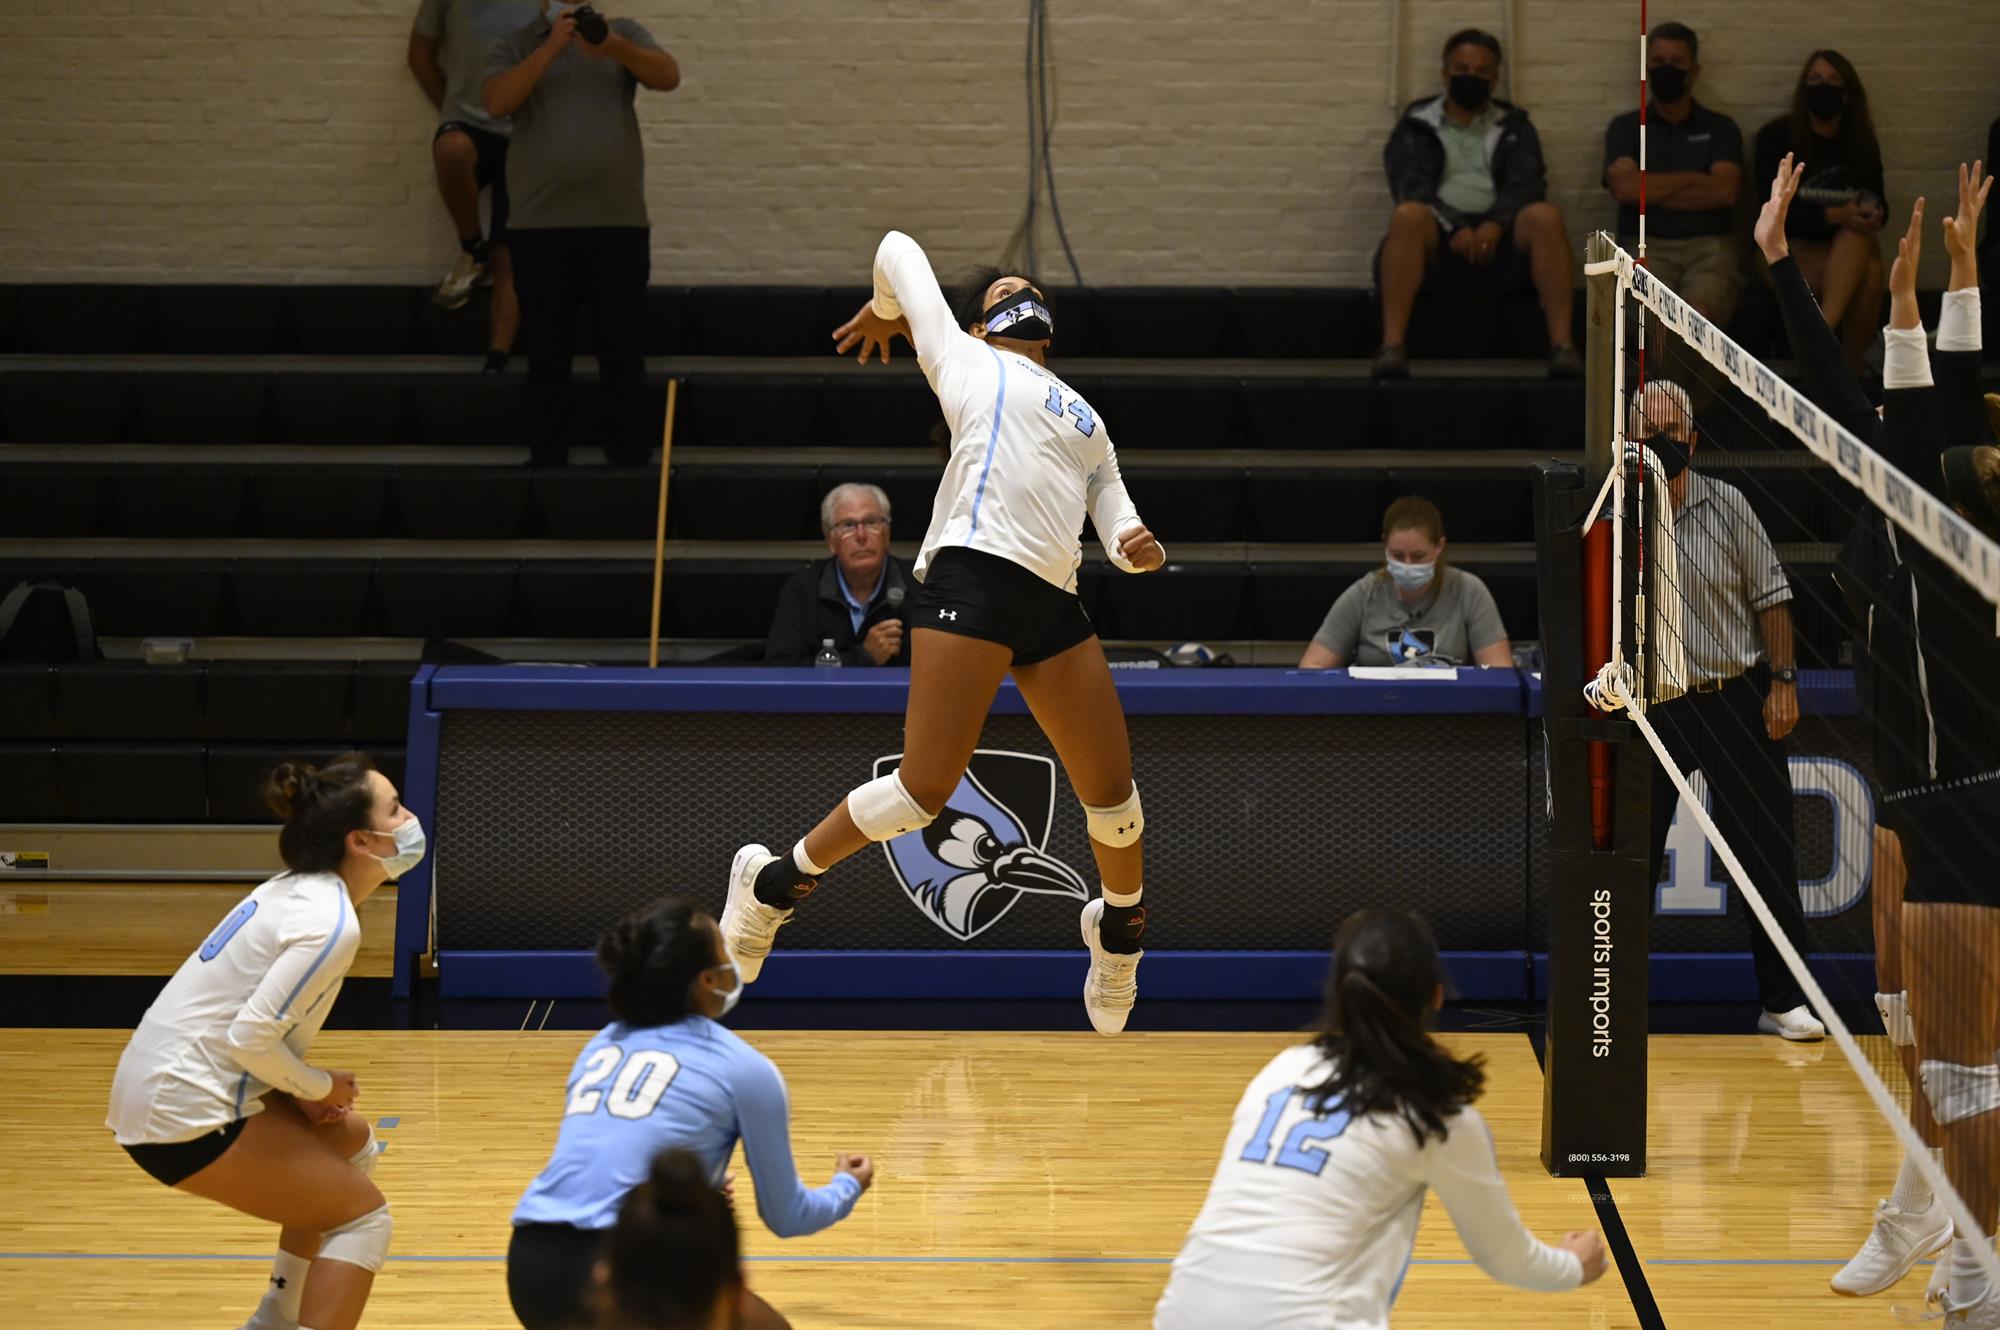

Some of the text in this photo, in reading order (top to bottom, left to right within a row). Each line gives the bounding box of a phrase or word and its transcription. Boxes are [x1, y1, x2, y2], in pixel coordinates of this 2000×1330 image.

[1045, 385, 1096, 439] 14
[1588, 889, 1614, 1058] sports imports
[565, 1043, 682, 1121] 20
[1239, 1084, 1353, 1176] 12
[1568, 1153, 1630, 1163] (800) 556-3198
